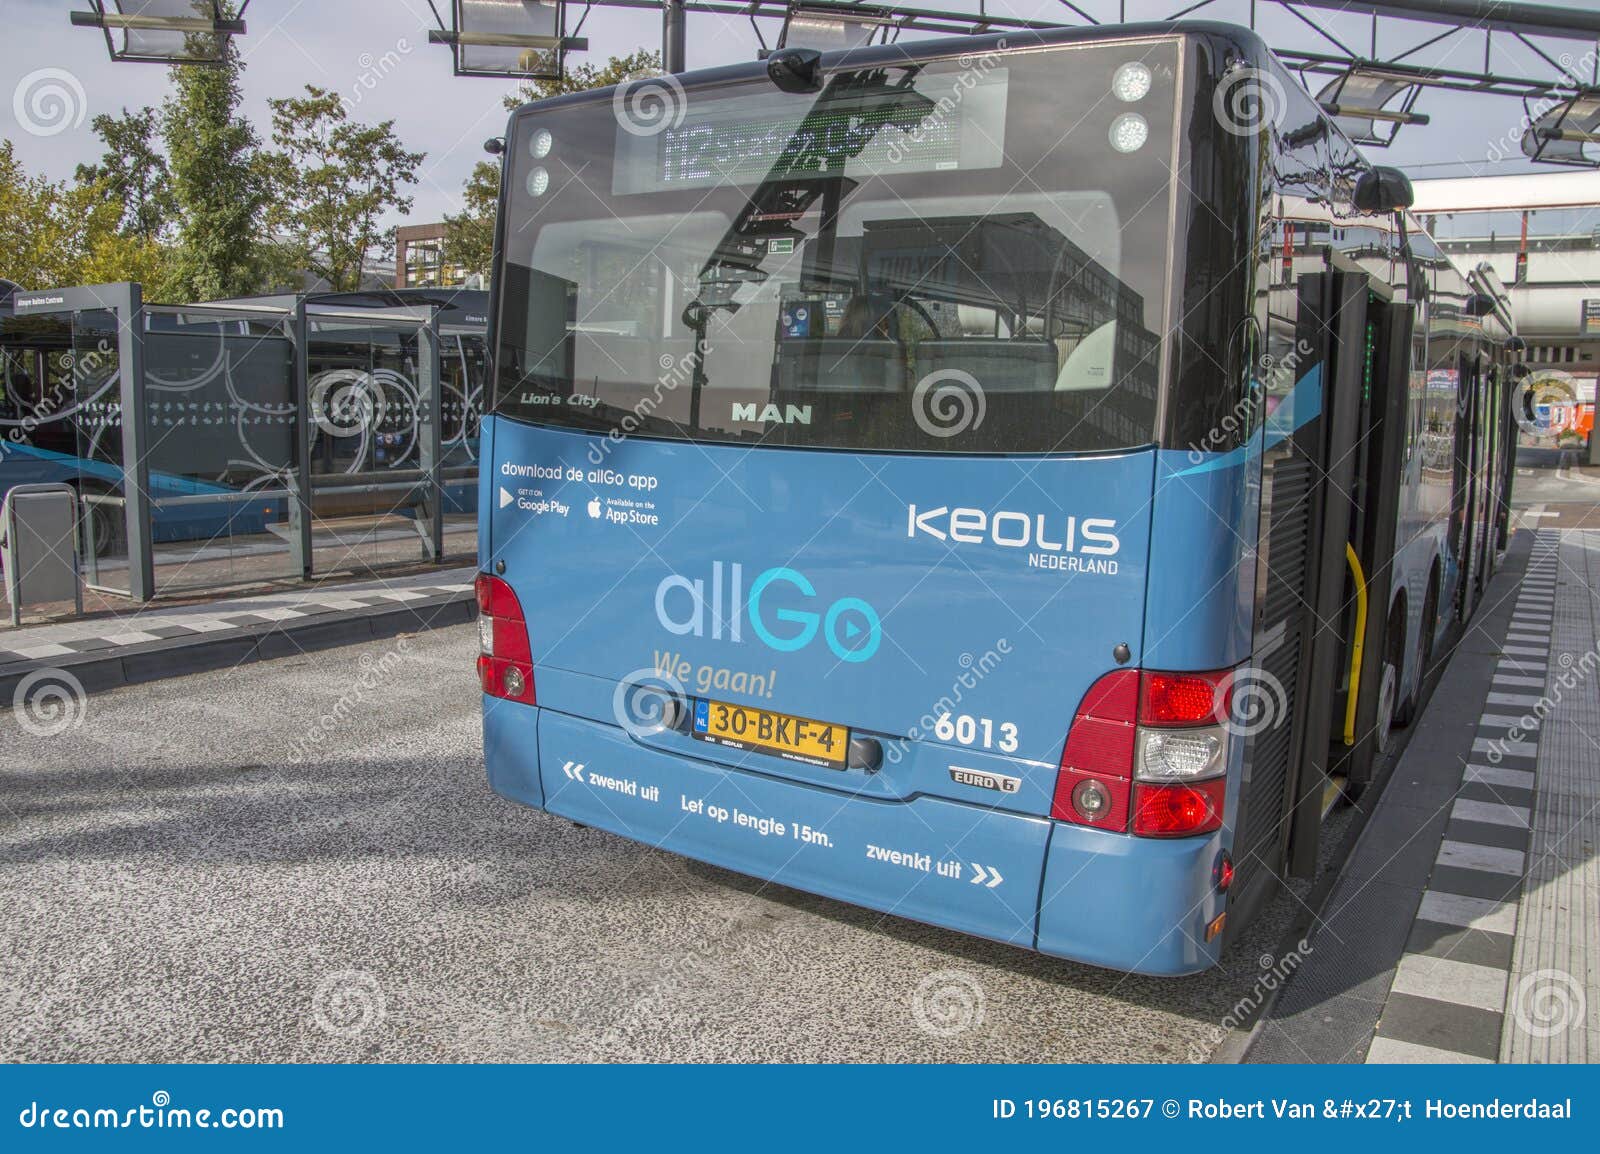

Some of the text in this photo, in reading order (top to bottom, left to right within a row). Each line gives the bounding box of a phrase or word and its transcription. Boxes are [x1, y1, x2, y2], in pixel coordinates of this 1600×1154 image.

[520, 392, 600, 408] Lion's City
[731, 402, 812, 425] MAN
[501, 461, 658, 492] download de allGo app
[518, 497, 570, 517] Google Play
[606, 498, 634, 508] Available
[645, 501, 656, 509] the
[606, 507, 659, 526] App Store
[1028, 552, 1119, 576] NEDERLAND
[654, 560, 882, 663] allGo
[654, 650, 777, 699] We gaan!
[696, 716, 707, 728] NL
[714, 704, 835, 753] 30-BKF-4
[934, 712, 1019, 753] 6013
[589, 772, 660, 803] zwenkt uit
[955, 771, 1015, 792] EURO 6
[681, 795, 834, 848] Let op lengte 15m.
[866, 844, 962, 879] zwenkt uit
